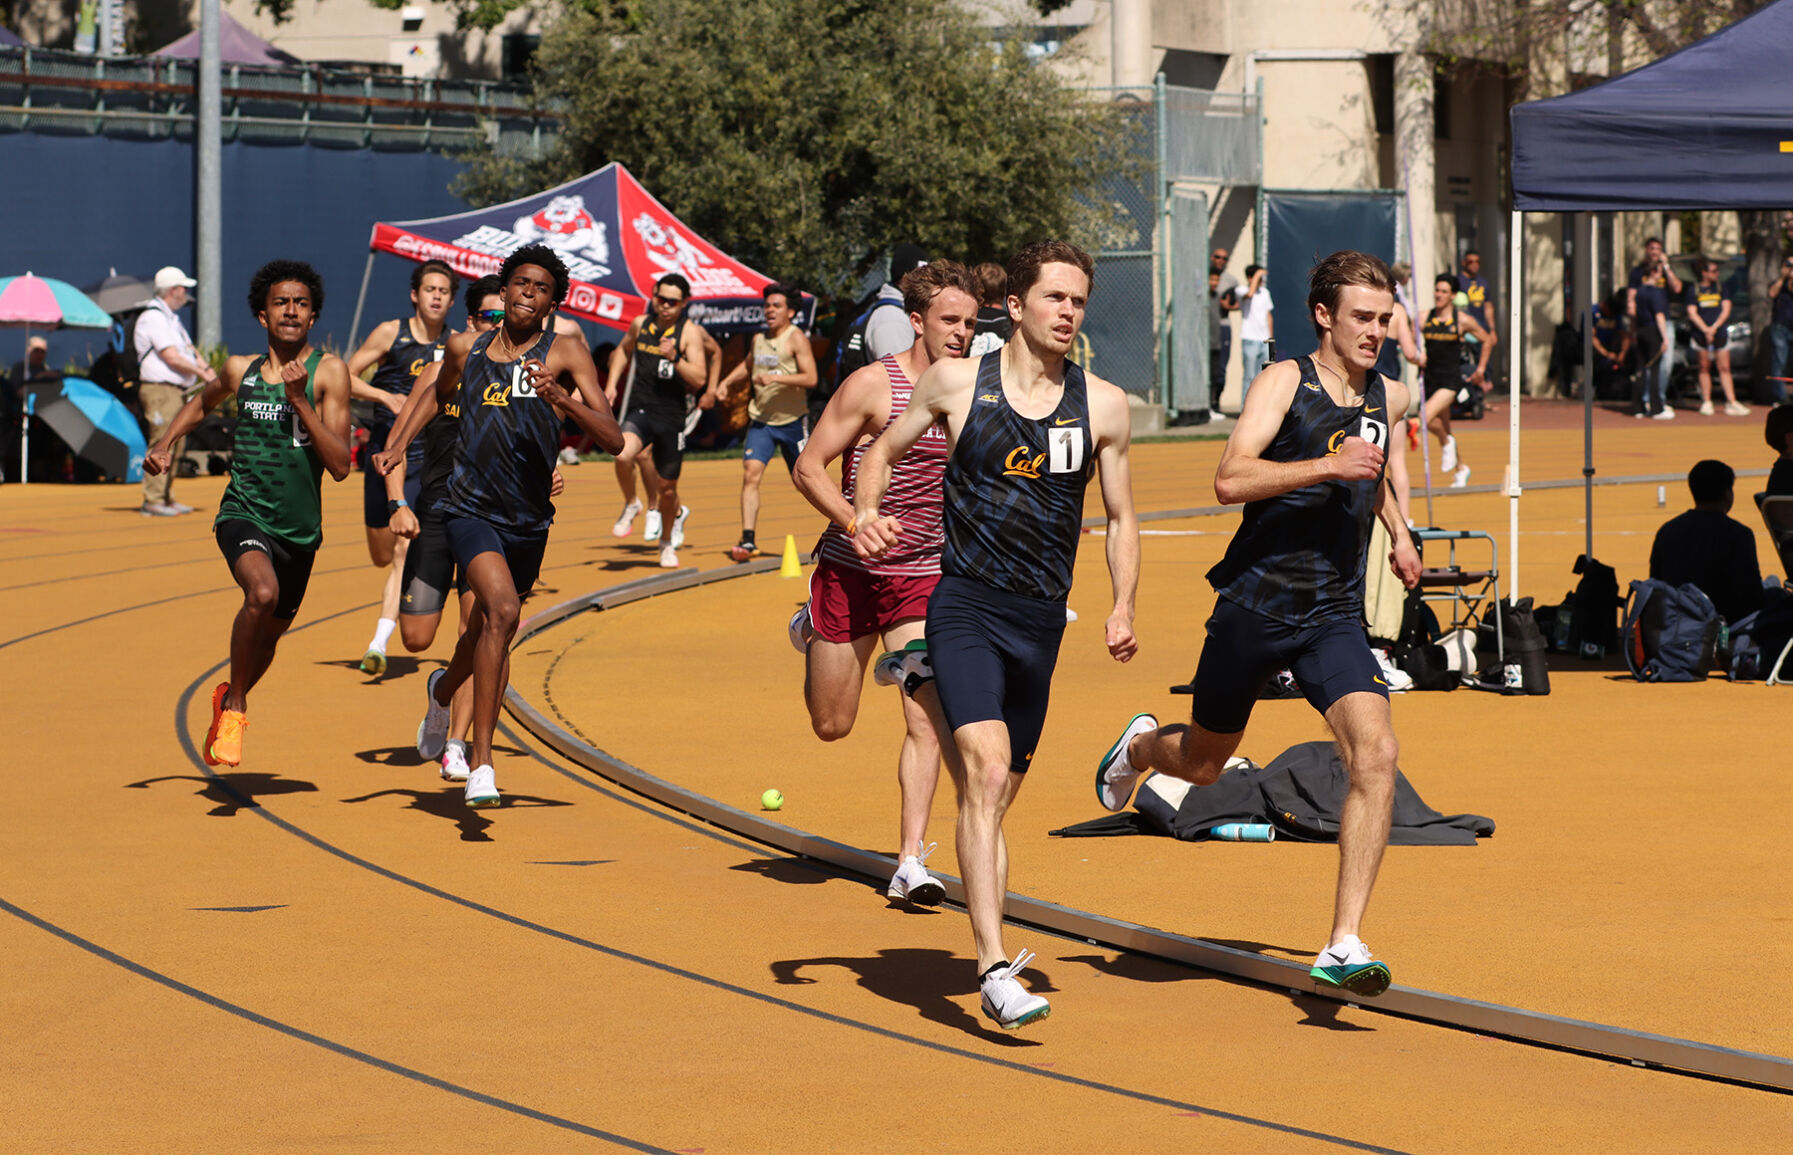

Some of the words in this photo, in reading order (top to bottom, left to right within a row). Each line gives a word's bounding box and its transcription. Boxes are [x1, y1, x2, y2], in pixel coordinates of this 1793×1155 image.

[662, 361, 670, 377] 8
[518, 366, 533, 395] 6
[482, 382, 512, 406] Cal
[978, 393, 999, 403] ACC
[244, 401, 296, 413] PORTLAN
[252, 410, 286, 422] STATE
[1058, 430, 1072, 470] 1
[1002, 445, 1047, 479] Cal
